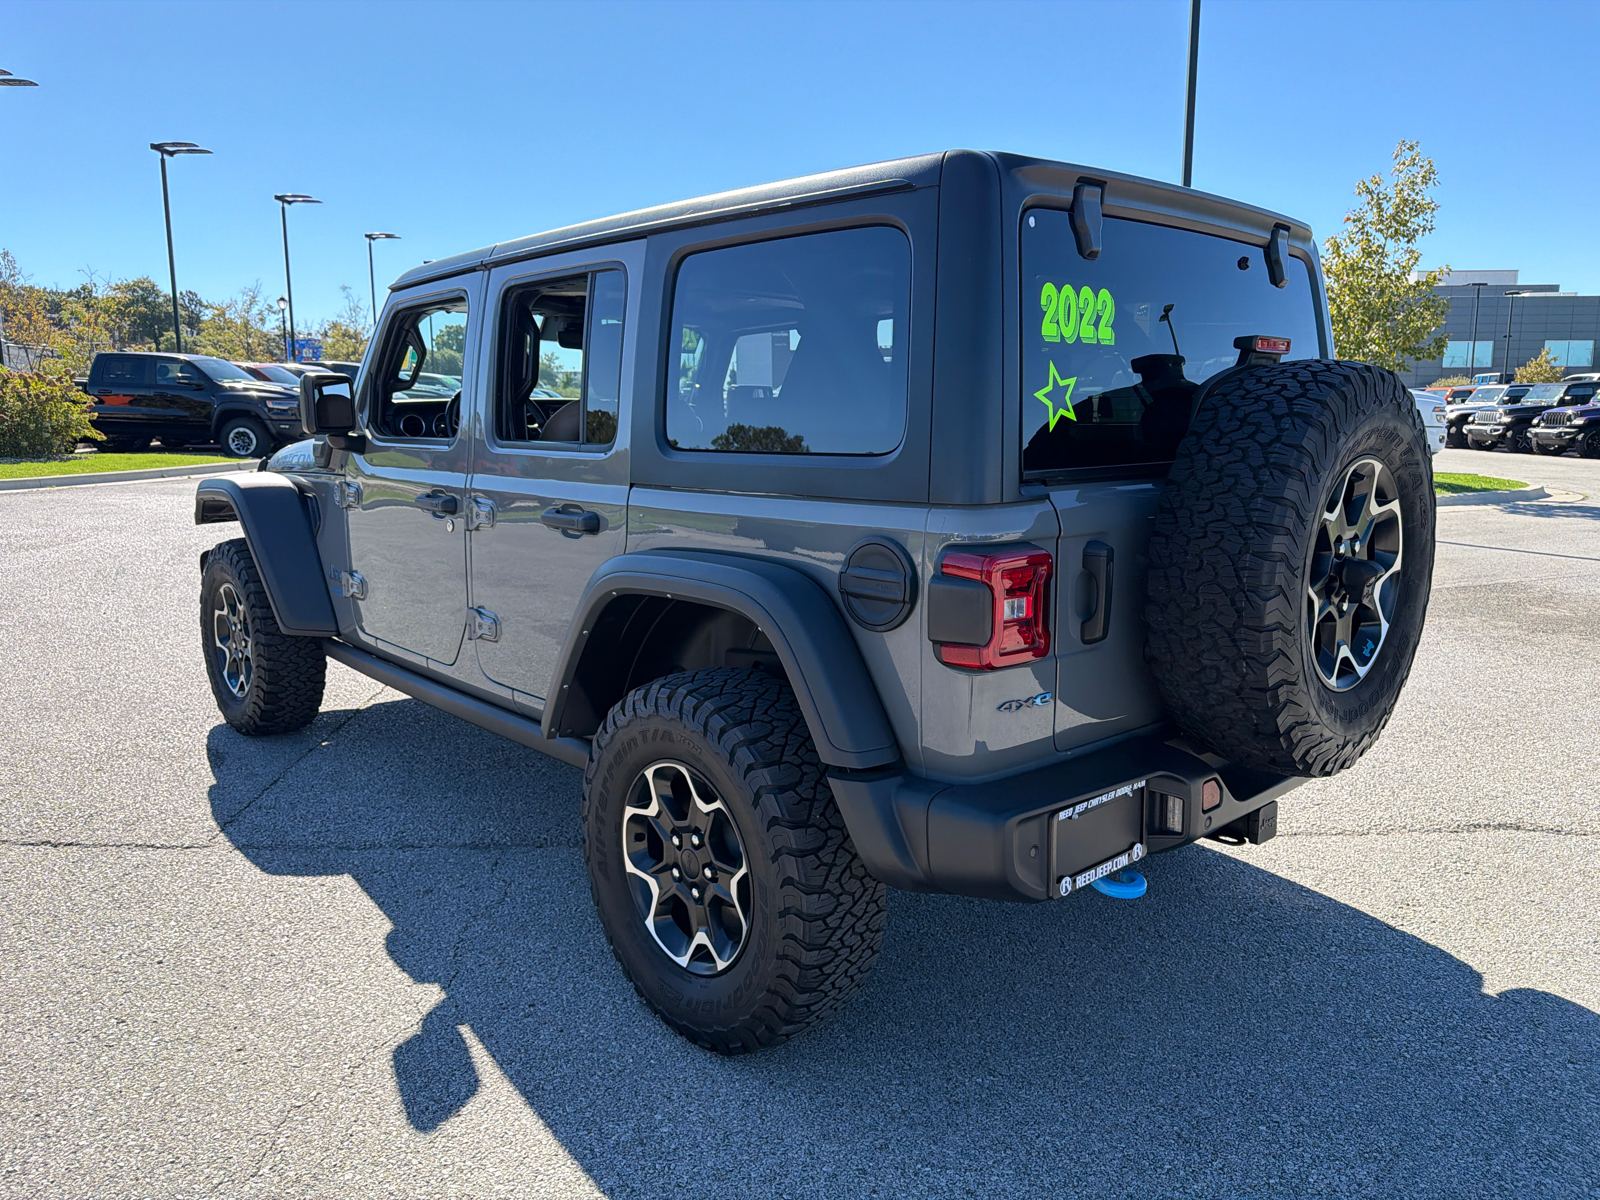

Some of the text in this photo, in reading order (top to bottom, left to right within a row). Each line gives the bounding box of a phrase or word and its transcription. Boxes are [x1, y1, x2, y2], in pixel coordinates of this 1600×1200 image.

[1040, 282, 1115, 345] 2022
[1059, 807, 1073, 821] REED
[1074, 802, 1088, 814] JEEP
[1088, 790, 1116, 809] CHRYSLER
[1076, 853, 1129, 889] REEDJEEP.COM
